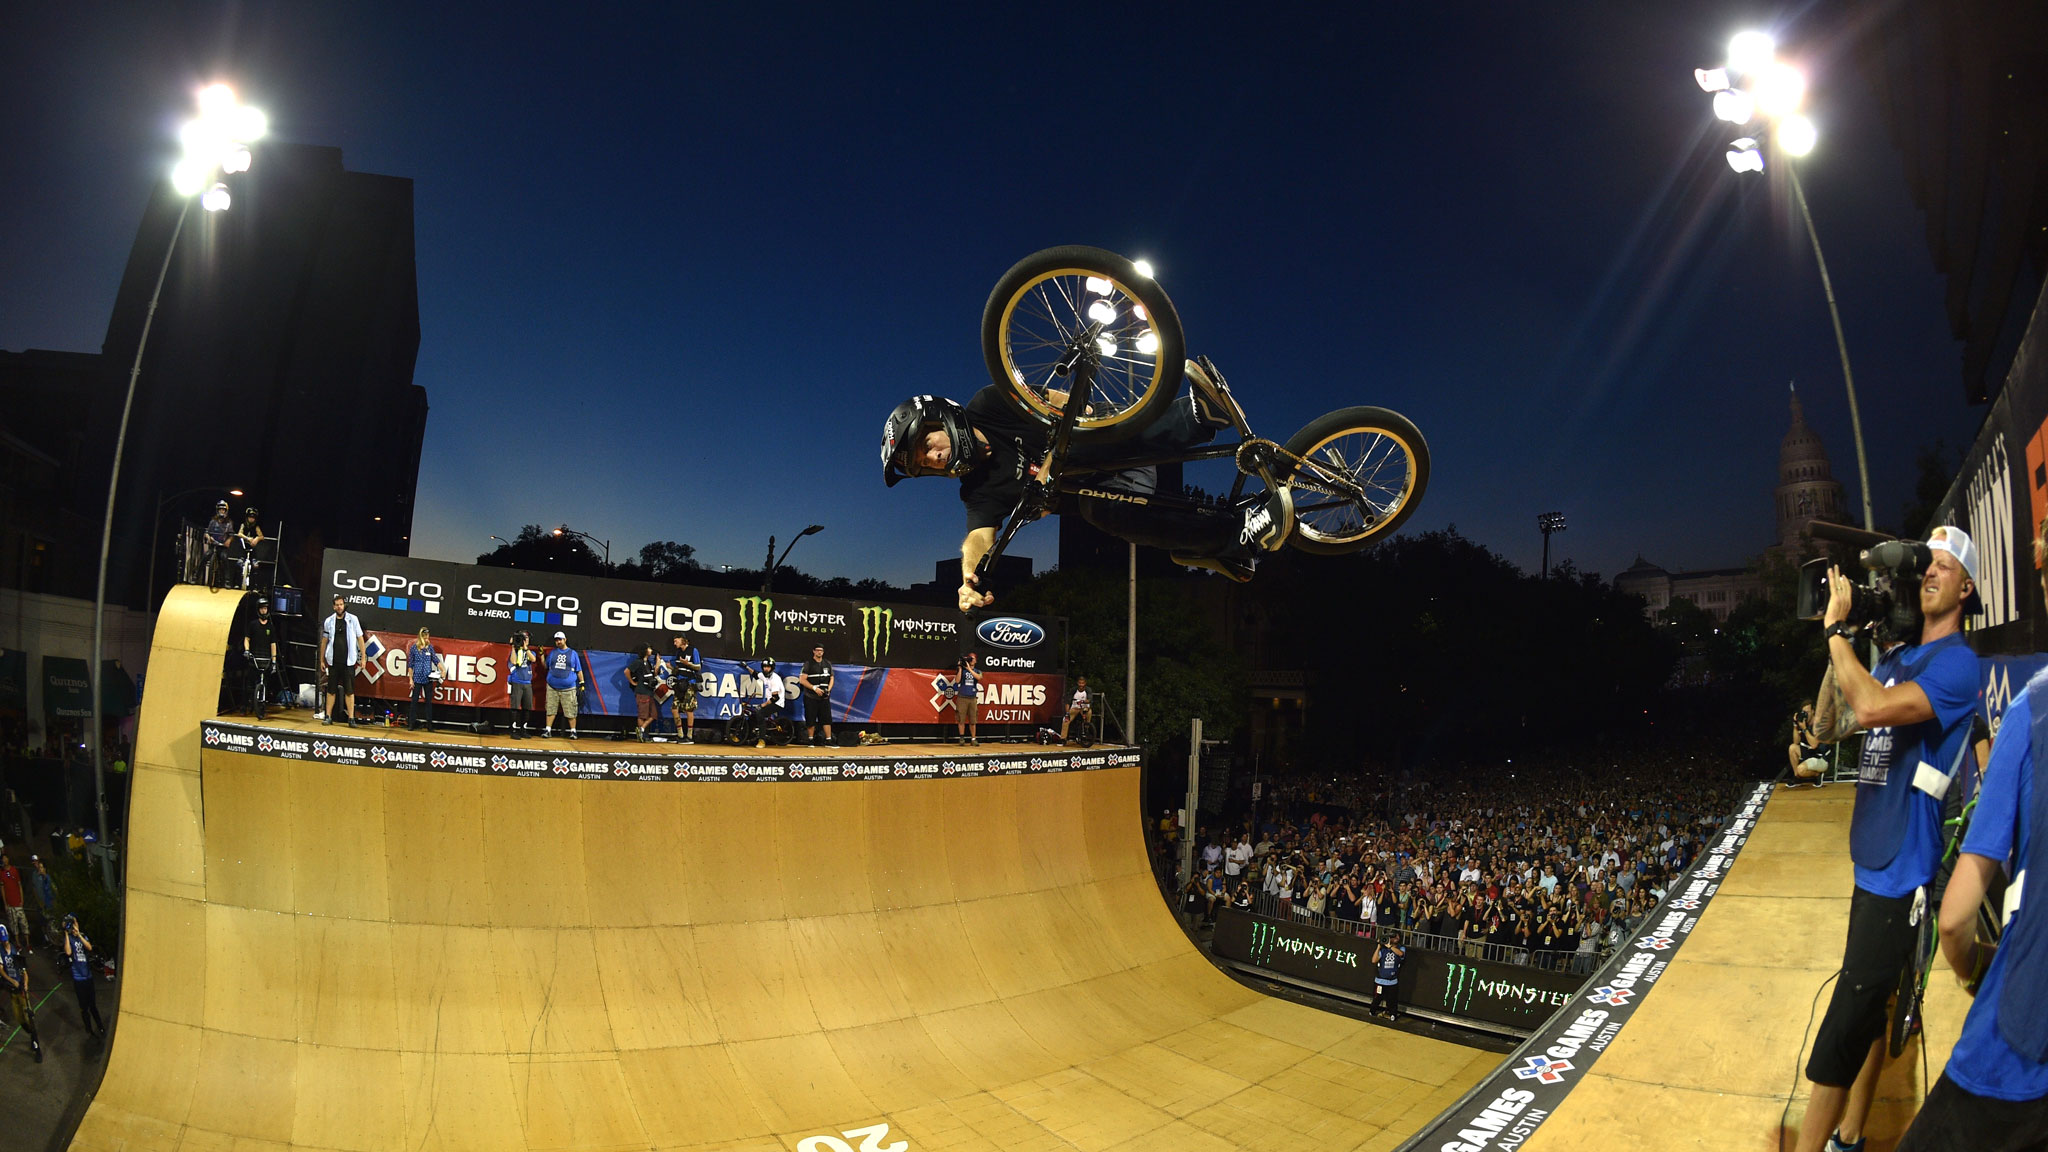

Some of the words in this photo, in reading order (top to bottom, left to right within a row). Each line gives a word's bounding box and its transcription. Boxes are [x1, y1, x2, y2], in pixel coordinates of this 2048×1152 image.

[333, 570, 442, 598] GoPro
[467, 584, 580, 612] GoPro
[468, 608, 478, 616] Be
[600, 600, 722, 634] GEICO
[774, 608, 846, 626] MONSTER
[784, 625, 836, 634] ENERGY
[894, 618, 957, 634] MONSTER
[903, 633, 948, 641] ENERGY
[990, 622, 1033, 644] Ford
[386, 648, 497, 684] GMES
[985, 656, 1000, 667] Go
[1001, 656, 1036, 668] Further
[700, 672, 801, 700] GAMS
[985, 709, 1031, 721] AUSTIN
[220, 732, 254, 747] GAMES
[273, 739, 308, 753] GAMES
[328, 744, 366, 758] GAMES
[387, 750, 426, 763] GAMES
[447, 754, 486, 767] GAMES
[508, 758, 548, 770] GAMES
[1000, 760, 1028, 770] GAMES
[1041, 758, 1068, 768] GAMES
[1081, 756, 1106, 766] GAMES
[1118, 754, 1140, 763] GAMES
[569, 761, 609, 773] GAMES
[630, 764, 669, 775] GAMES
[690, 765, 728, 775] GAMES
[748, 766, 784, 776] GAMES
[804, 765, 839, 776] GAMES
[856, 765, 890, 775] GAMES
[908, 764, 939, 774] GAMES
[955, 762, 985, 772] GAMES
[1652, 911, 1687, 938] GAMES
[1276, 936, 1357, 968] MONSTER
[1610, 952, 1656, 989] GAMES
[1644, 961, 1668, 984] AUSTIN
[1546, 1008, 1610, 1059] GAMES
[1588, 1022, 1622, 1052] AUSTIN
[1497, 1108, 1548, 1152] AUSTIN
